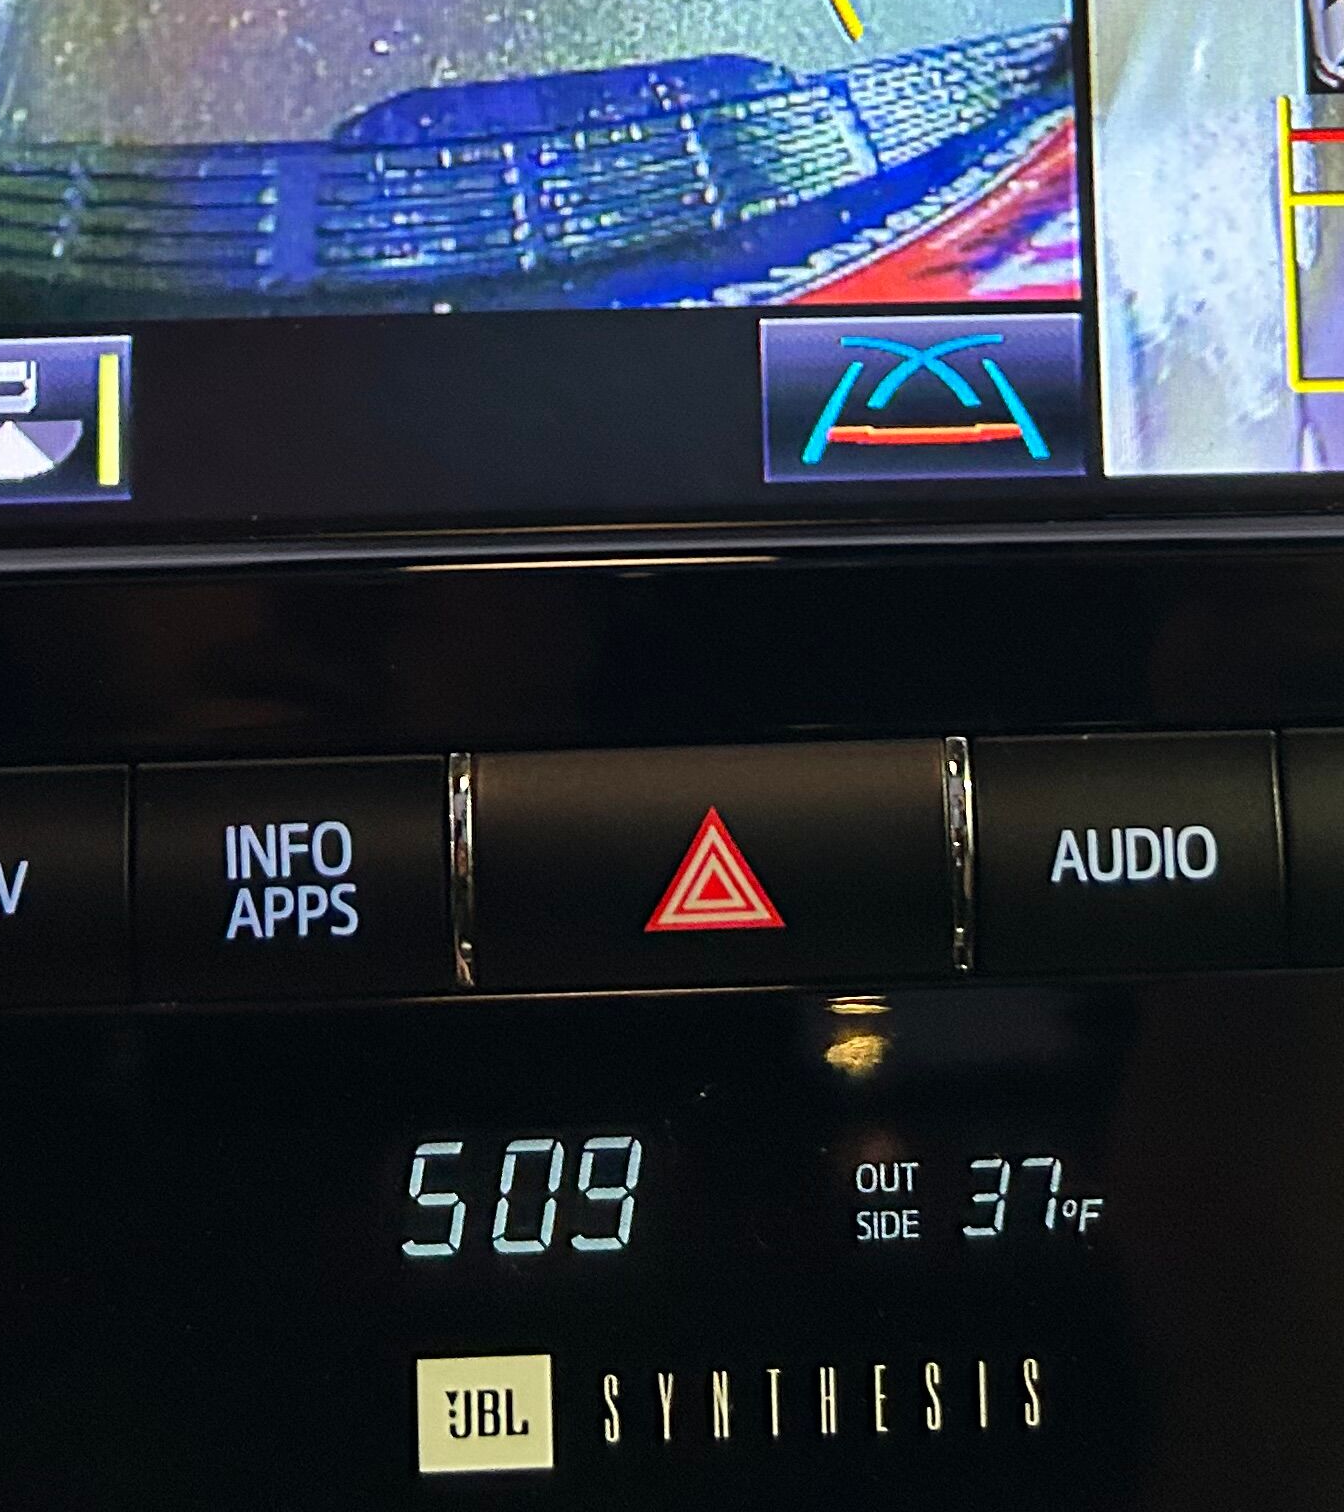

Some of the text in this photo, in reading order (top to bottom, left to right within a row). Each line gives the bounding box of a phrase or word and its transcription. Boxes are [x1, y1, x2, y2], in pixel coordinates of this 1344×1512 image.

[224, 821, 353, 880] INFO
[1050, 824, 1219, 884] AUDIO
[225, 883, 360, 940] APPS
[400, 1135, 643, 1258] 509
[855, 1161, 920, 1194] OUT
[855, 1209, 920, 1241] SIDE
[445, 1357, 1041, 1444] JBL SYNTHESIS
